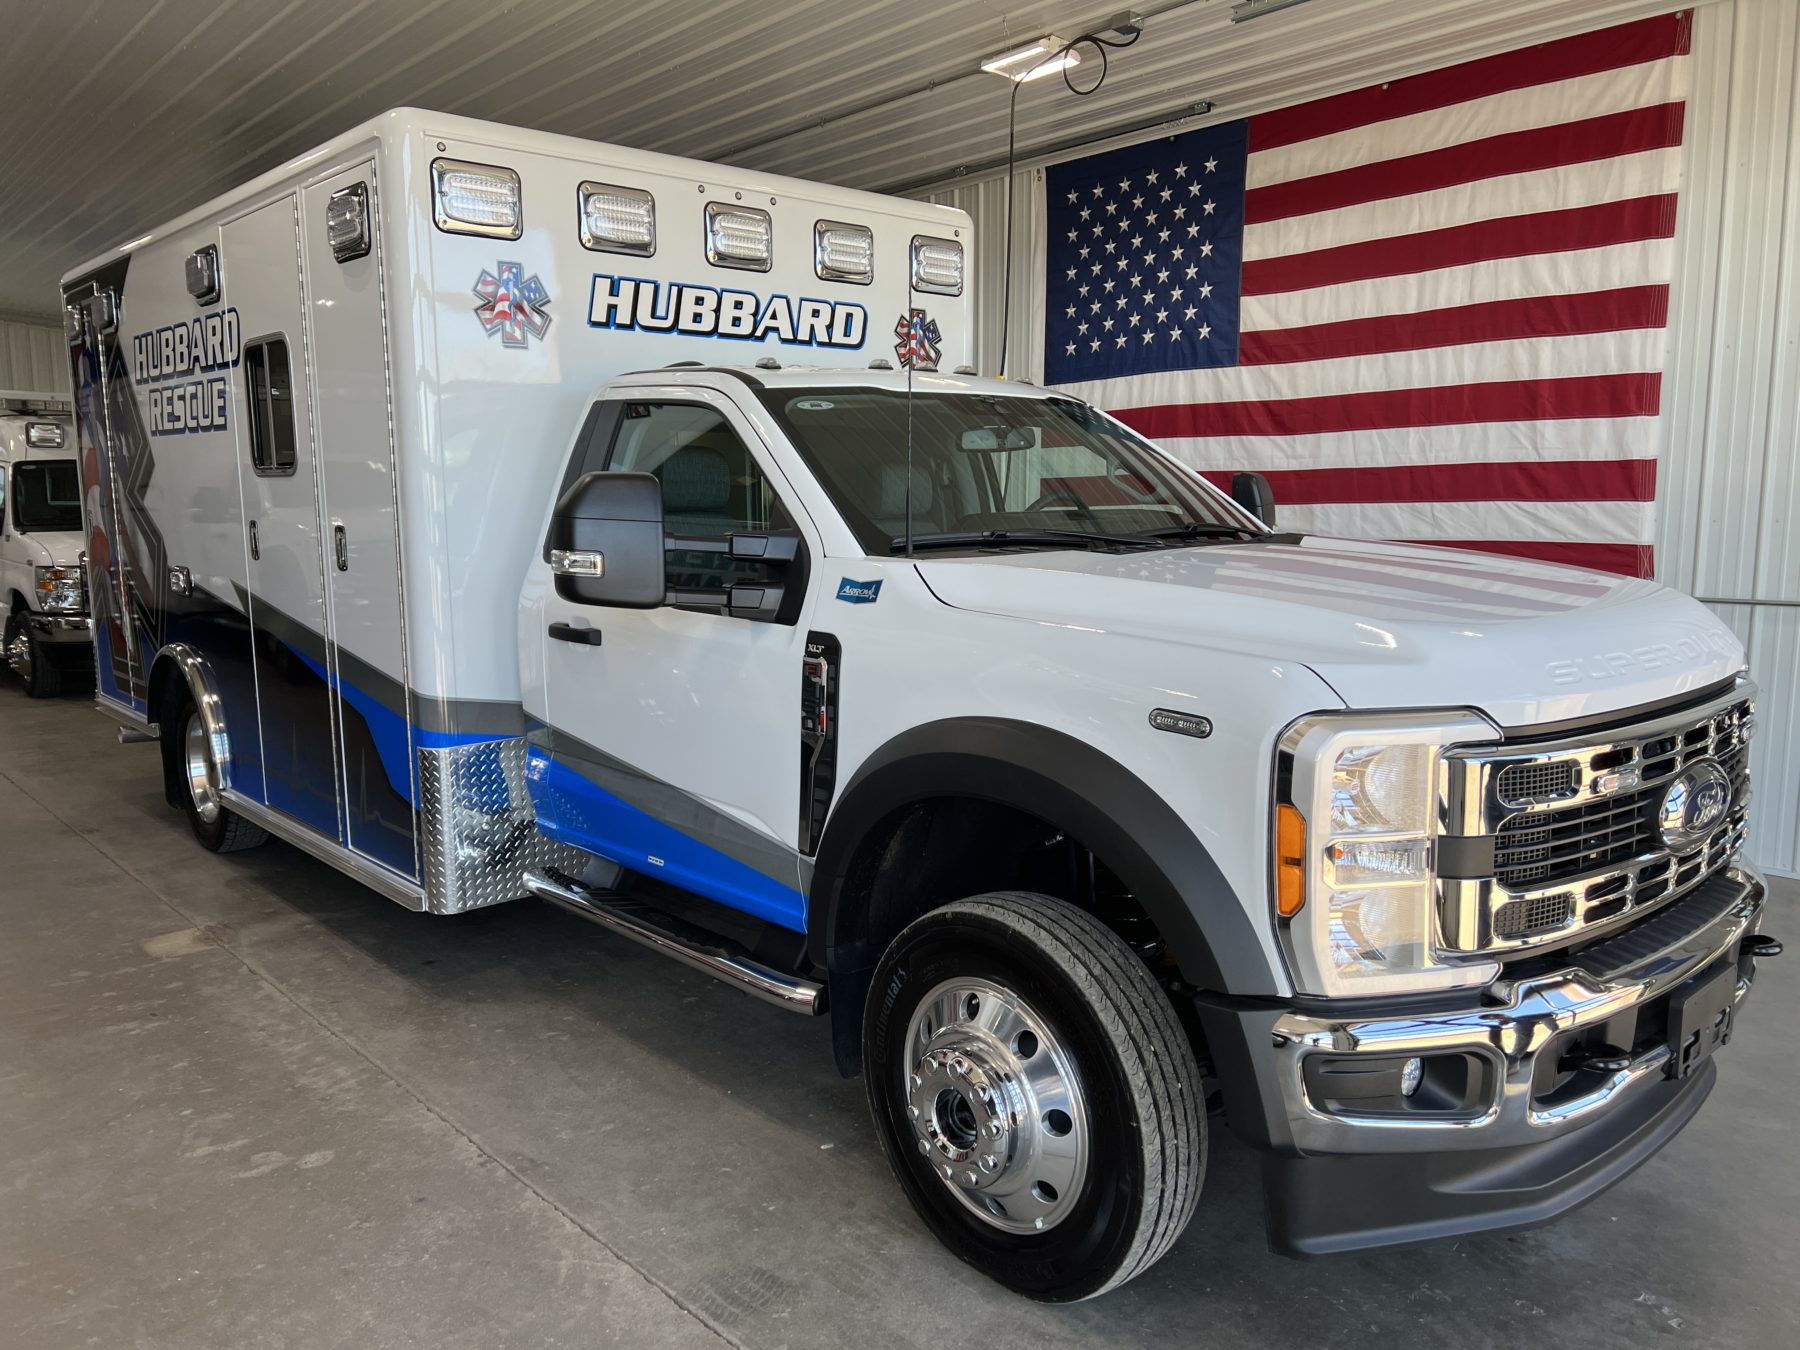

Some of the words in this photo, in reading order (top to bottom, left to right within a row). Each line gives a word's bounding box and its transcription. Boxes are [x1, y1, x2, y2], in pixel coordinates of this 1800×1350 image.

[587, 273, 868, 350] HUBBARD
[134, 307, 240, 386] HUBBARD
[149, 376, 228, 436] RESCUE
[807, 643, 825, 653] XLT
[1693, 783, 1724, 825] Ford
